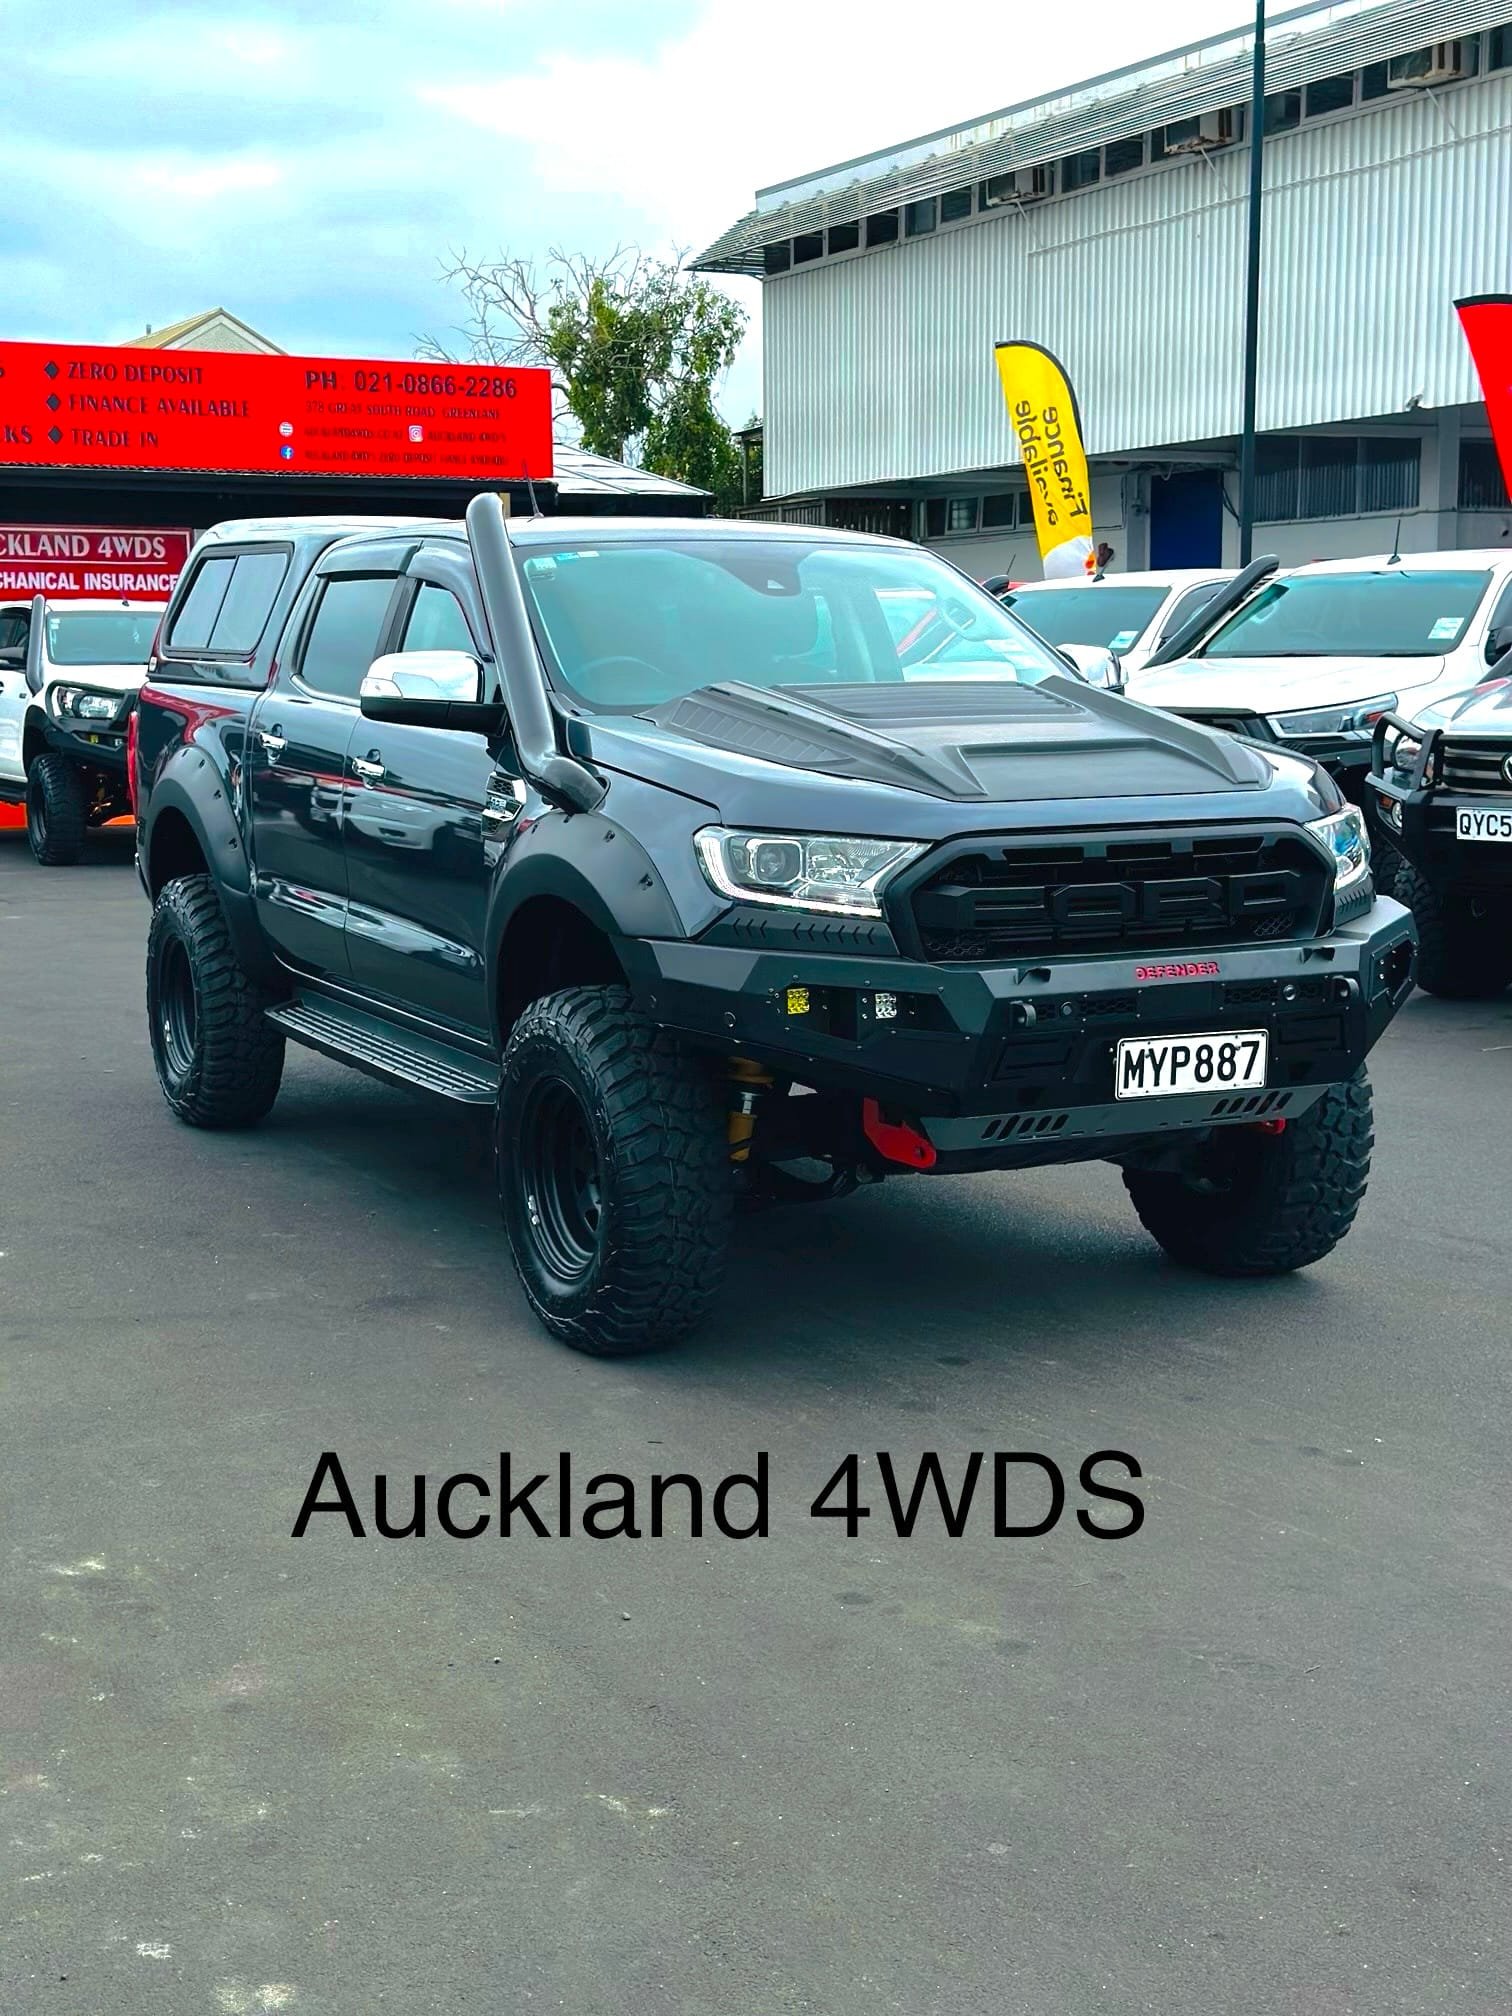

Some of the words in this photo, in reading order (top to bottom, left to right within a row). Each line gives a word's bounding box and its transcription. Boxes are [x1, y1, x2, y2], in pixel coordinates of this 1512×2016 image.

[68, 361, 117, 380] ZERO
[124, 365, 203, 384] DEPOSIT
[354, 370, 517, 398] 021-0866-2286
[69, 393, 148, 413] FINANCE
[157, 398, 250, 417] AVAILABLE
[71, 428, 129, 447] TRADE
[140, 431, 158, 448] IN
[98, 536, 166, 558] 4WDS
[1459, 813, 1512, 837] QYC5
[1135, 961, 1219, 981] DEFENDER
[1123, 1040, 1260, 1090] MYP887
